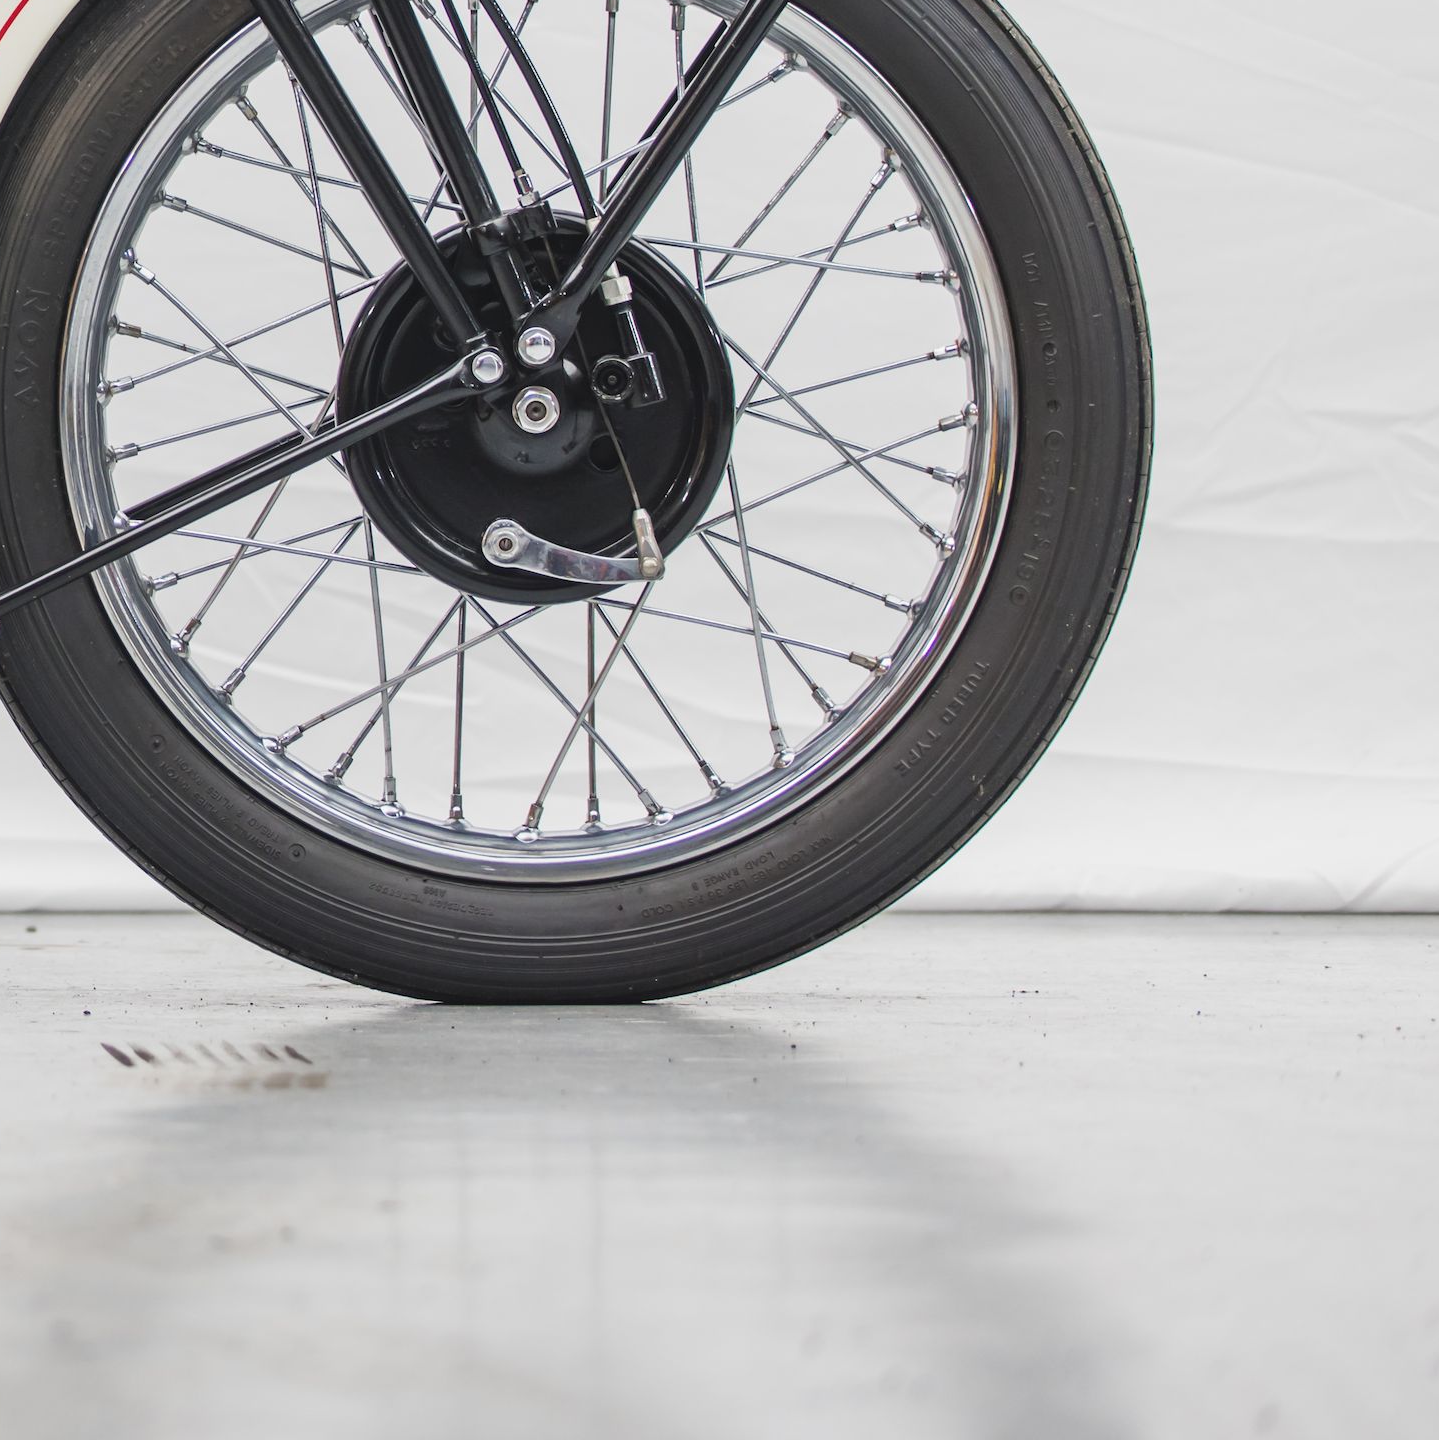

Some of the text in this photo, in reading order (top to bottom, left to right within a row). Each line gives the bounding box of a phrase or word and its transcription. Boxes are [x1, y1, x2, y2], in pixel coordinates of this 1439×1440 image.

[893, 727, 943, 776] TYPE
[743, 850, 775, 871] LOAD
[702, 866, 740, 887] RANGE
